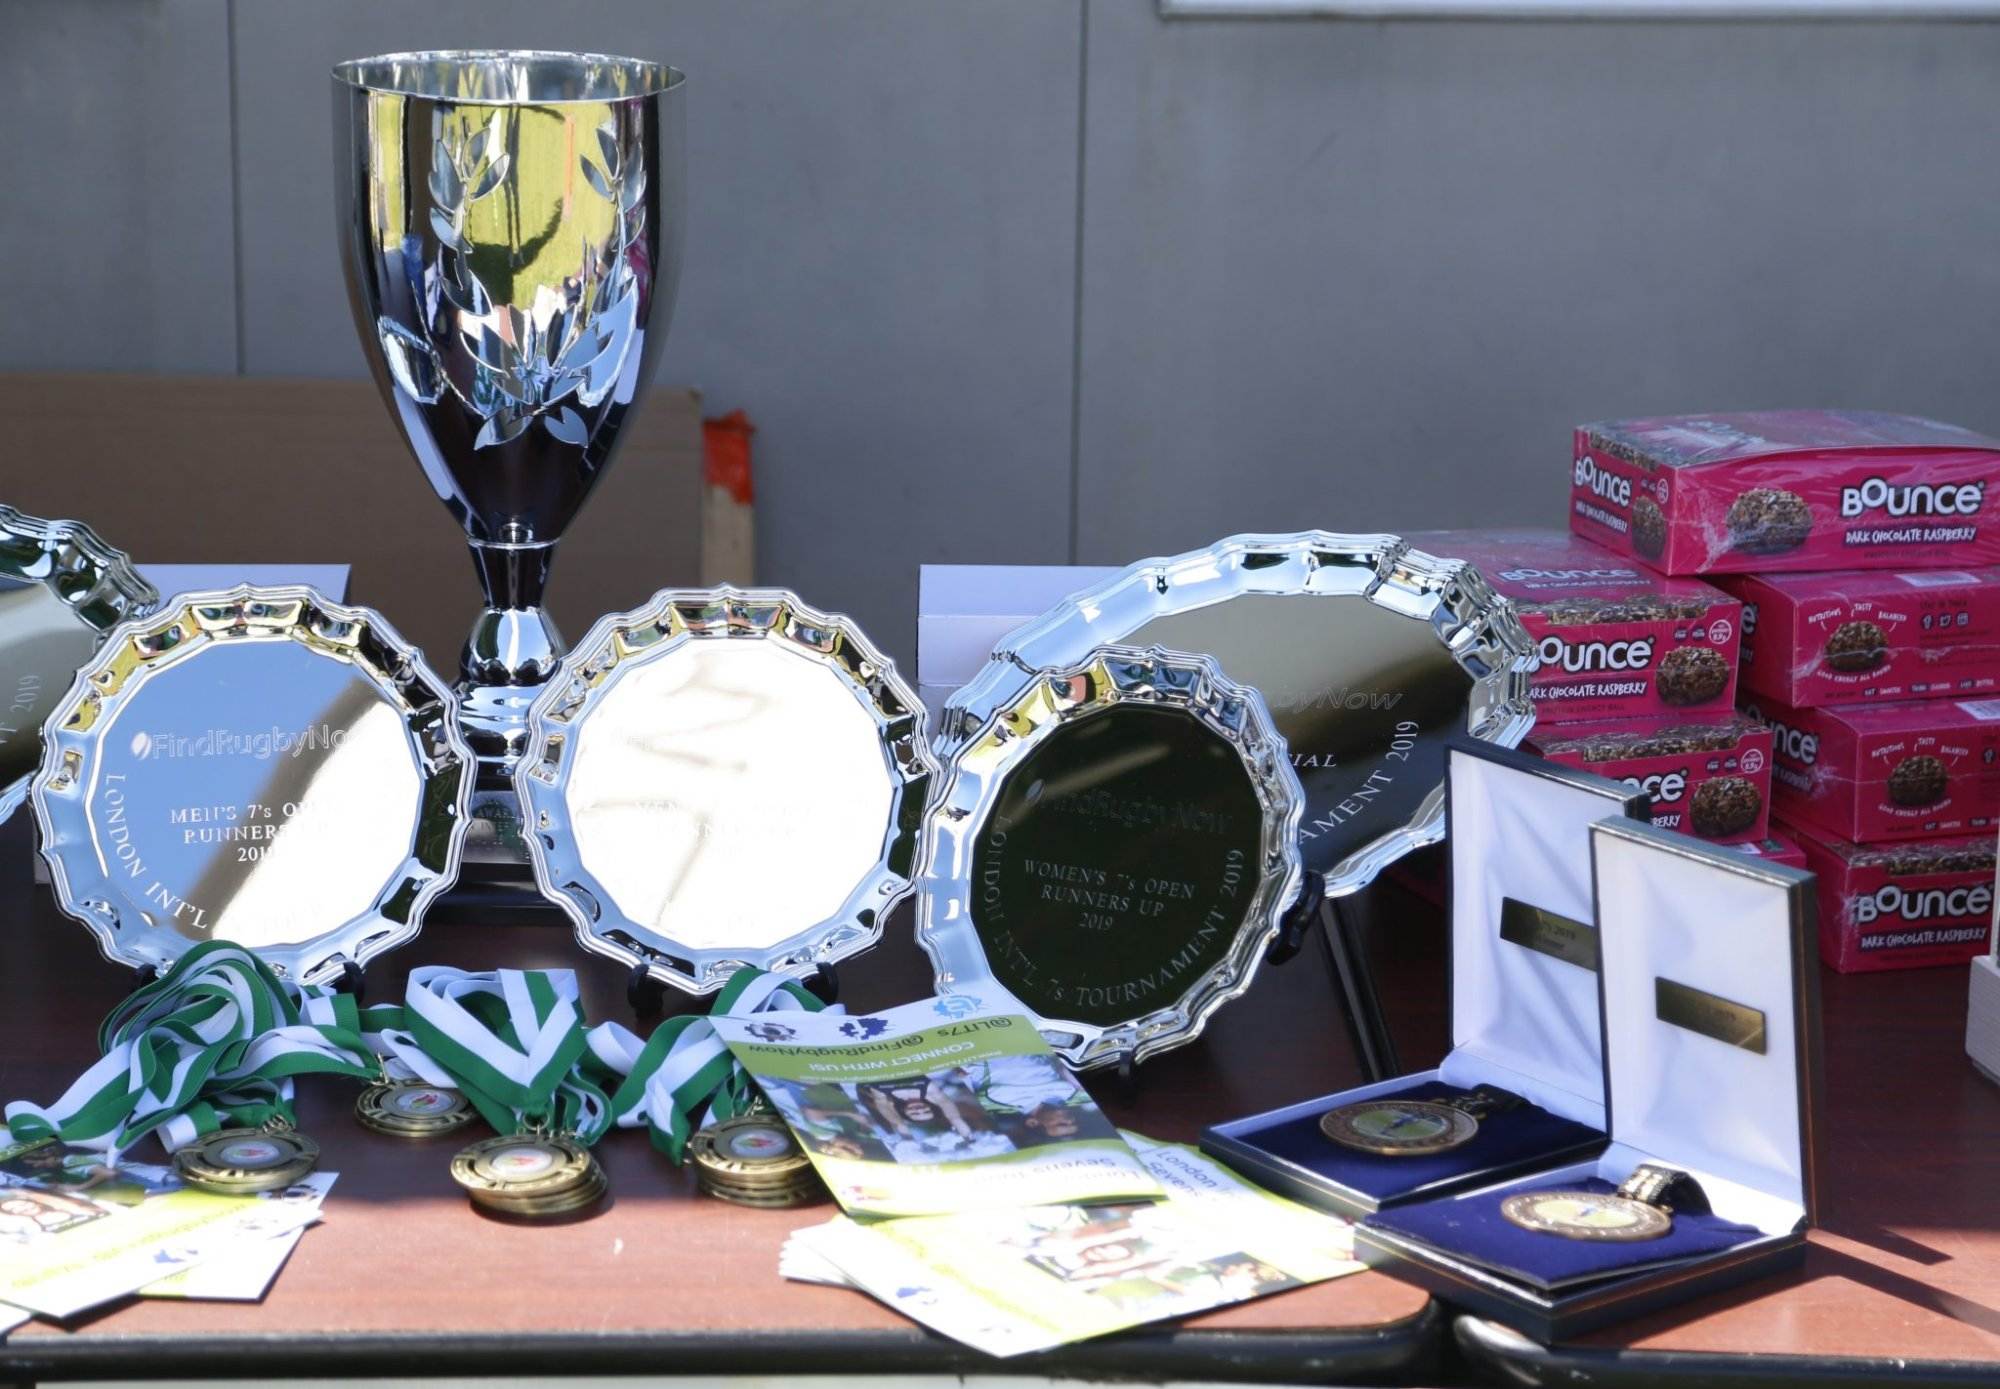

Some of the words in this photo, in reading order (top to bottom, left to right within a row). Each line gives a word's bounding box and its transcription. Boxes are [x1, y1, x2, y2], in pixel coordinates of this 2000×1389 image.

[1846, 530, 1870, 544] DARK
[1872, 527, 1922, 543] CHOCOLATE
[1923, 526, 1977, 543] RASPBERRY
[1536, 636, 1652, 673] Ounce
[8, 674, 40, 713] 2019
[1529, 684, 1548, 699] ARK
[1549, 683, 1596, 699] CHOCOLATE
[1597, 681, 1648, 697] RASPBERRY
[151, 723, 347, 760] FindRugbyNo
[1385, 721, 1420, 762] 2019
[1289, 753, 1337, 768] IAL
[247, 804, 272, 819] 7's
[1298, 769, 1394, 844] AMENT
[1652, 814, 1681, 828] BERRY
[105, 773, 146, 878] LONDON
[145, 881, 208, 930] INT'L
[1023, 859, 1107, 886] WOMEN'S
[1144, 878, 1196, 900] OPEN
[1040, 884, 1130, 911] RUNNERS
[1138, 900, 1166, 918] UP
[1071, 905, 1226, 1008] TOURNAMENT
[1219, 848, 1246, 898] 2019
[1078, 912, 1114, 931] 2019
[1861, 936, 1885, 949] DARK
[1887, 931, 1935, 947] CHOCOLATE
[1936, 928, 1987, 943] RASPBERRY
[936, 1017, 1013, 1038] @LIT7s
[749, 1034, 924, 1058] @FindRugbyNow
[890, 1040, 975, 1067] CONNECT
[841, 1058, 888, 1072] WITH
[1156, 1150, 1218, 1189] London
